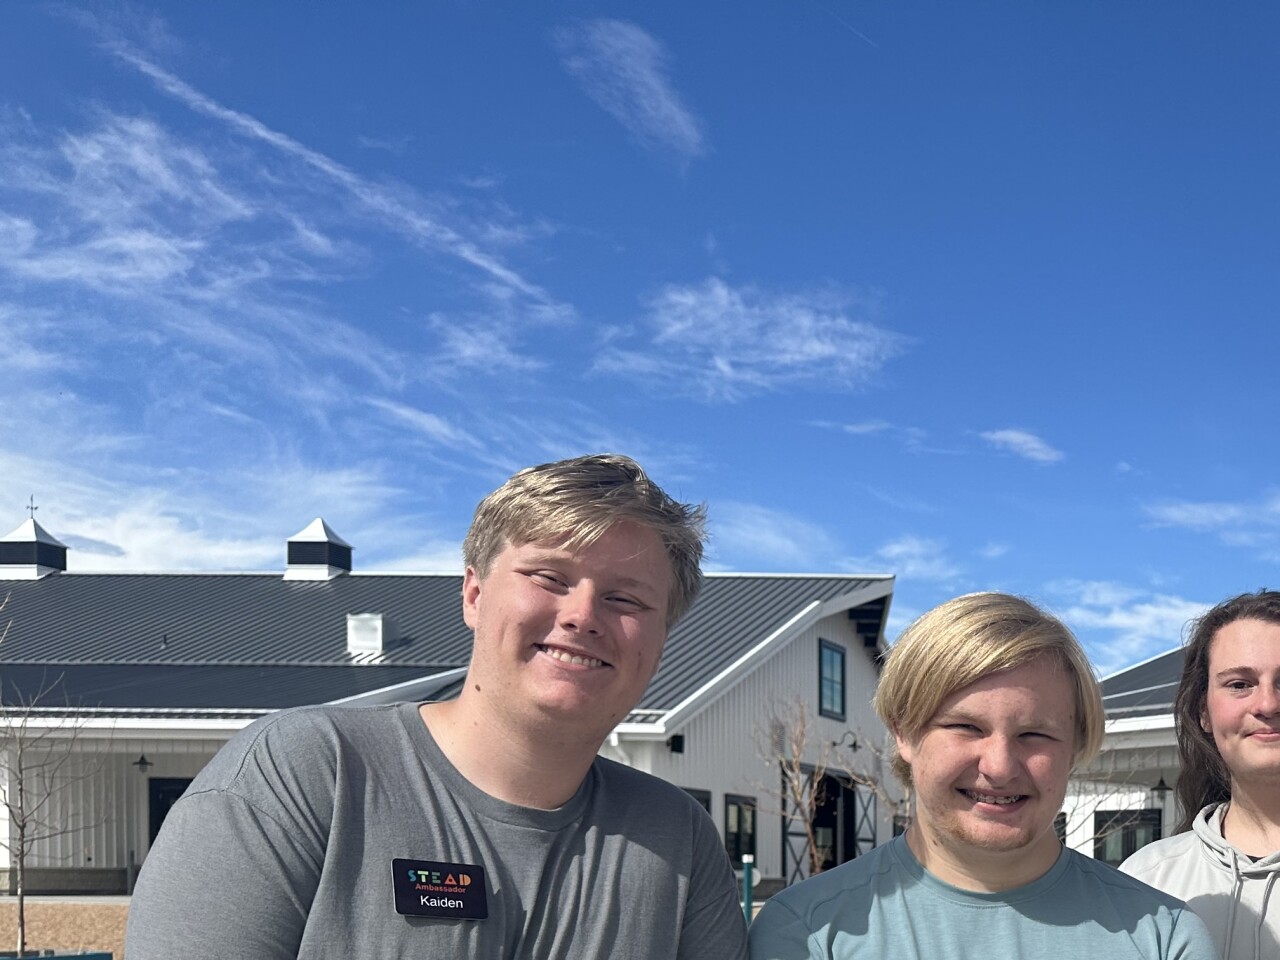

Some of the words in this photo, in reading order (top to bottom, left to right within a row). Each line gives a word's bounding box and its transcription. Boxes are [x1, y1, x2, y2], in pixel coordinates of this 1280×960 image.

[408, 869, 472, 886] STEAD
[415, 883, 467, 894] Ambassador
[420, 895, 464, 909] Kaiden
